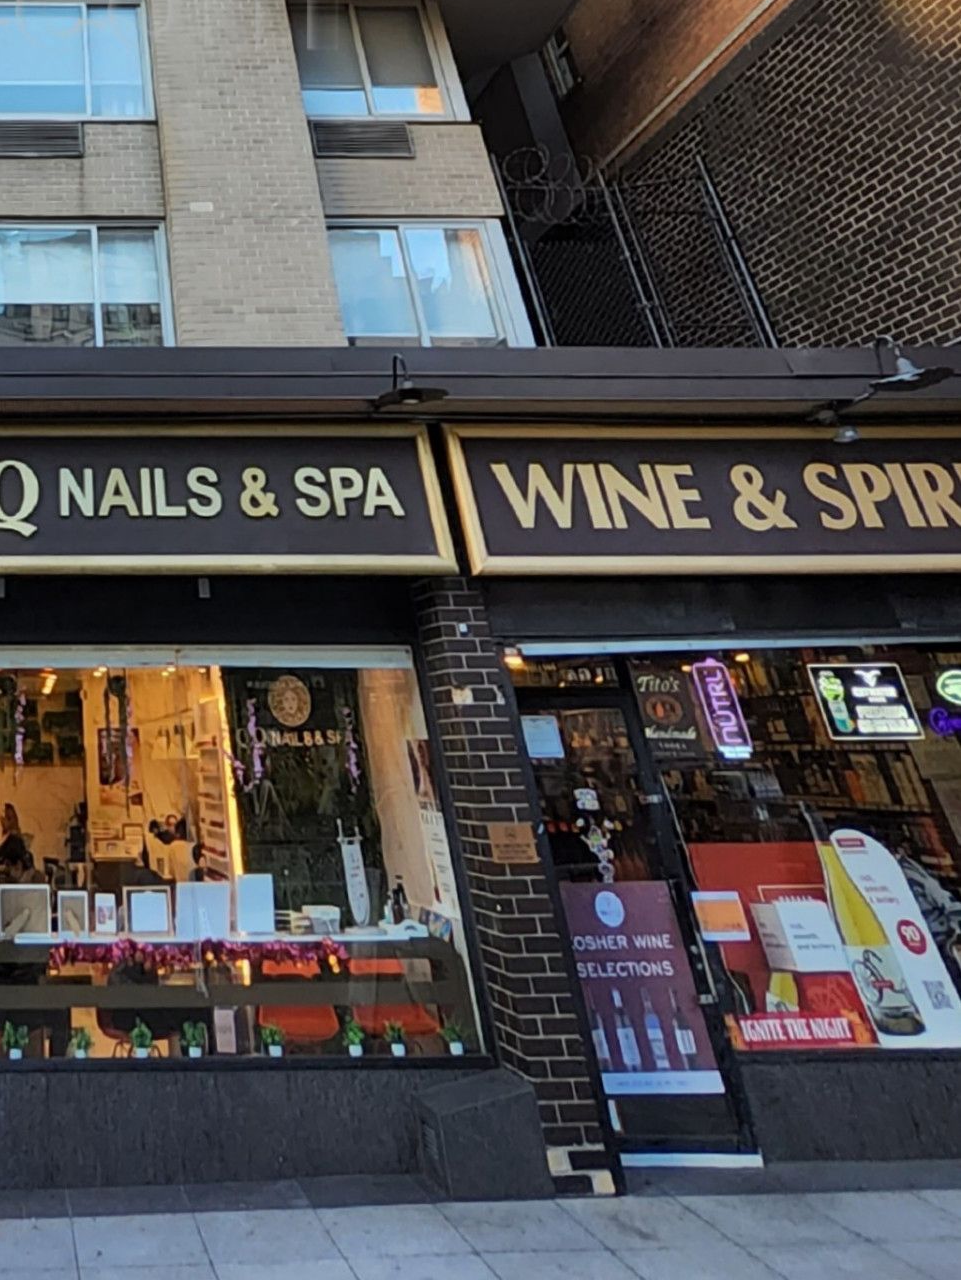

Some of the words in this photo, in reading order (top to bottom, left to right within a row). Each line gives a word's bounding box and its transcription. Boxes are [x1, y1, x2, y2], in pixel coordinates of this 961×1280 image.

[59, 467, 222, 517] NAILS
[240, 467, 279, 517] &
[294, 467, 405, 517] SPA
[490, 463, 711, 529] WINE
[729, 463, 798, 531] &
[803, 462, 961, 530] SPIR
[637, 674, 680, 693] Tito's
[571, 935, 629, 951] OSHER
[632, 933, 674, 950] WINE
[902, 925, 922, 942] 90
[577, 960, 675, 979] SELECTIONS
[740, 1019, 788, 1042] IGNITE
[784, 1018, 812, 1041] THE
[809, 1017, 853, 1040] NIGHT
